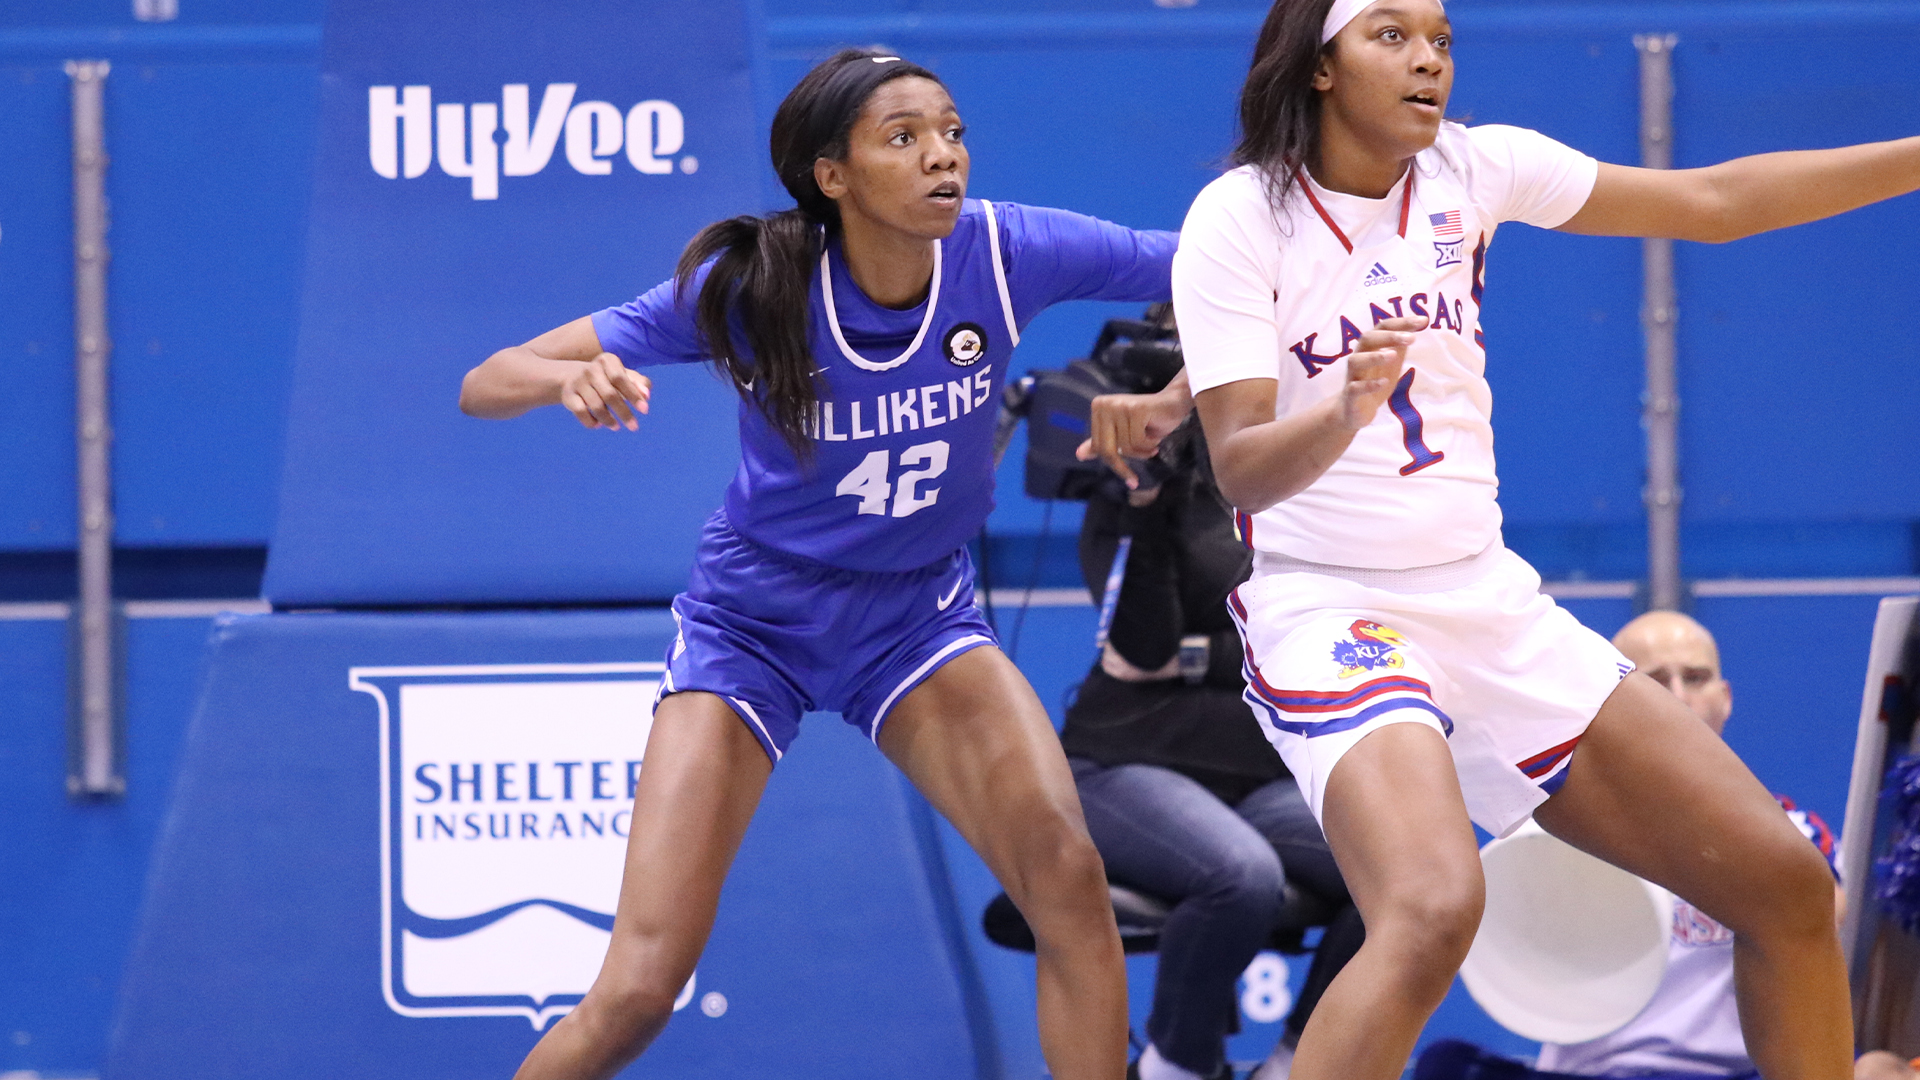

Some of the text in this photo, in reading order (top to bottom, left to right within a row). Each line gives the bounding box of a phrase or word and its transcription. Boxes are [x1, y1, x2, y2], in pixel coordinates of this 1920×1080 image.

[1363, 275, 1398, 287] adidas
[1290, 291, 1463, 379] KANSAS
[802, 364, 992, 441] ILLIKENS
[1387, 367, 1445, 477] 1
[835, 439, 951, 518] 42
[1354, 646, 1380, 659] KU
[415, 810, 632, 840] INSURANC
[1241, 952, 1292, 1023] 8
